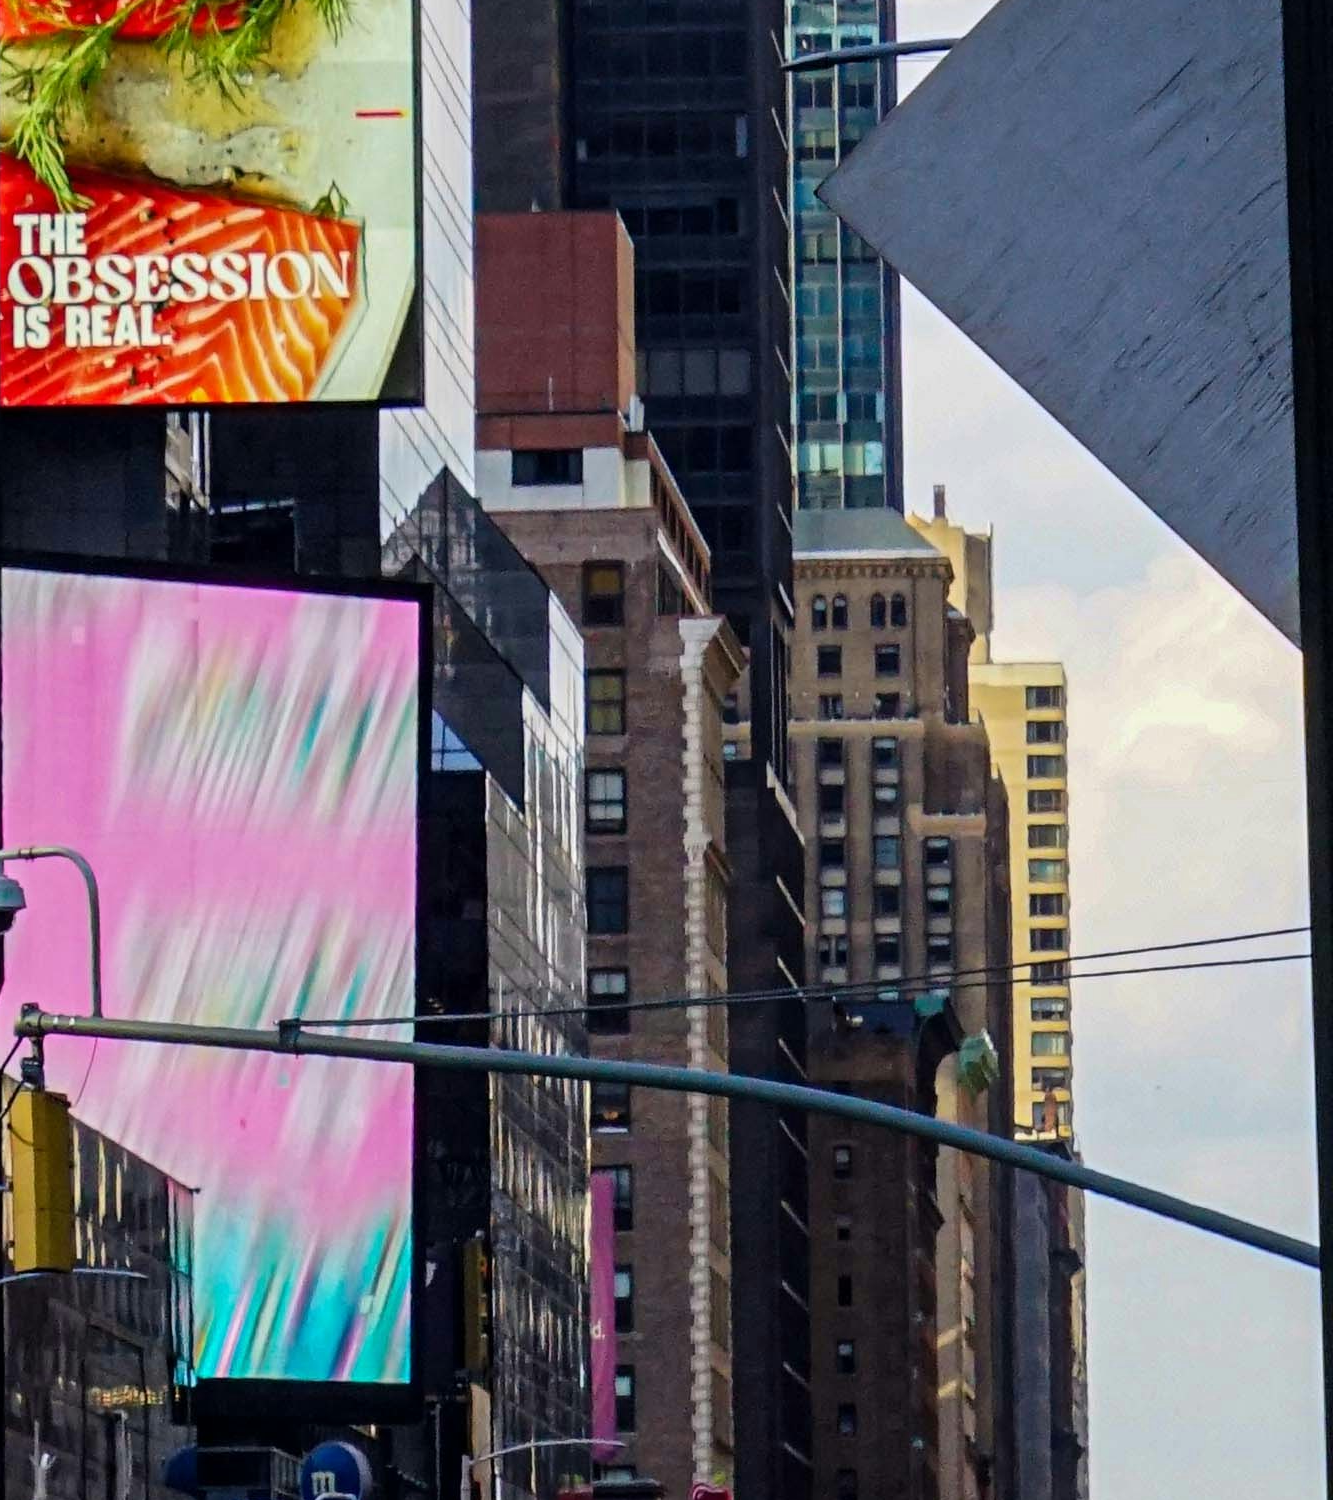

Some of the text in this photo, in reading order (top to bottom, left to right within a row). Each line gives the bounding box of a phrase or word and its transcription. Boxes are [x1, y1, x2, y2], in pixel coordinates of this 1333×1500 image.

[13, 214, 87, 256] THE
[8, 251, 351, 305] OBSESSION
[13, 303, 172, 349] IS REAL.
